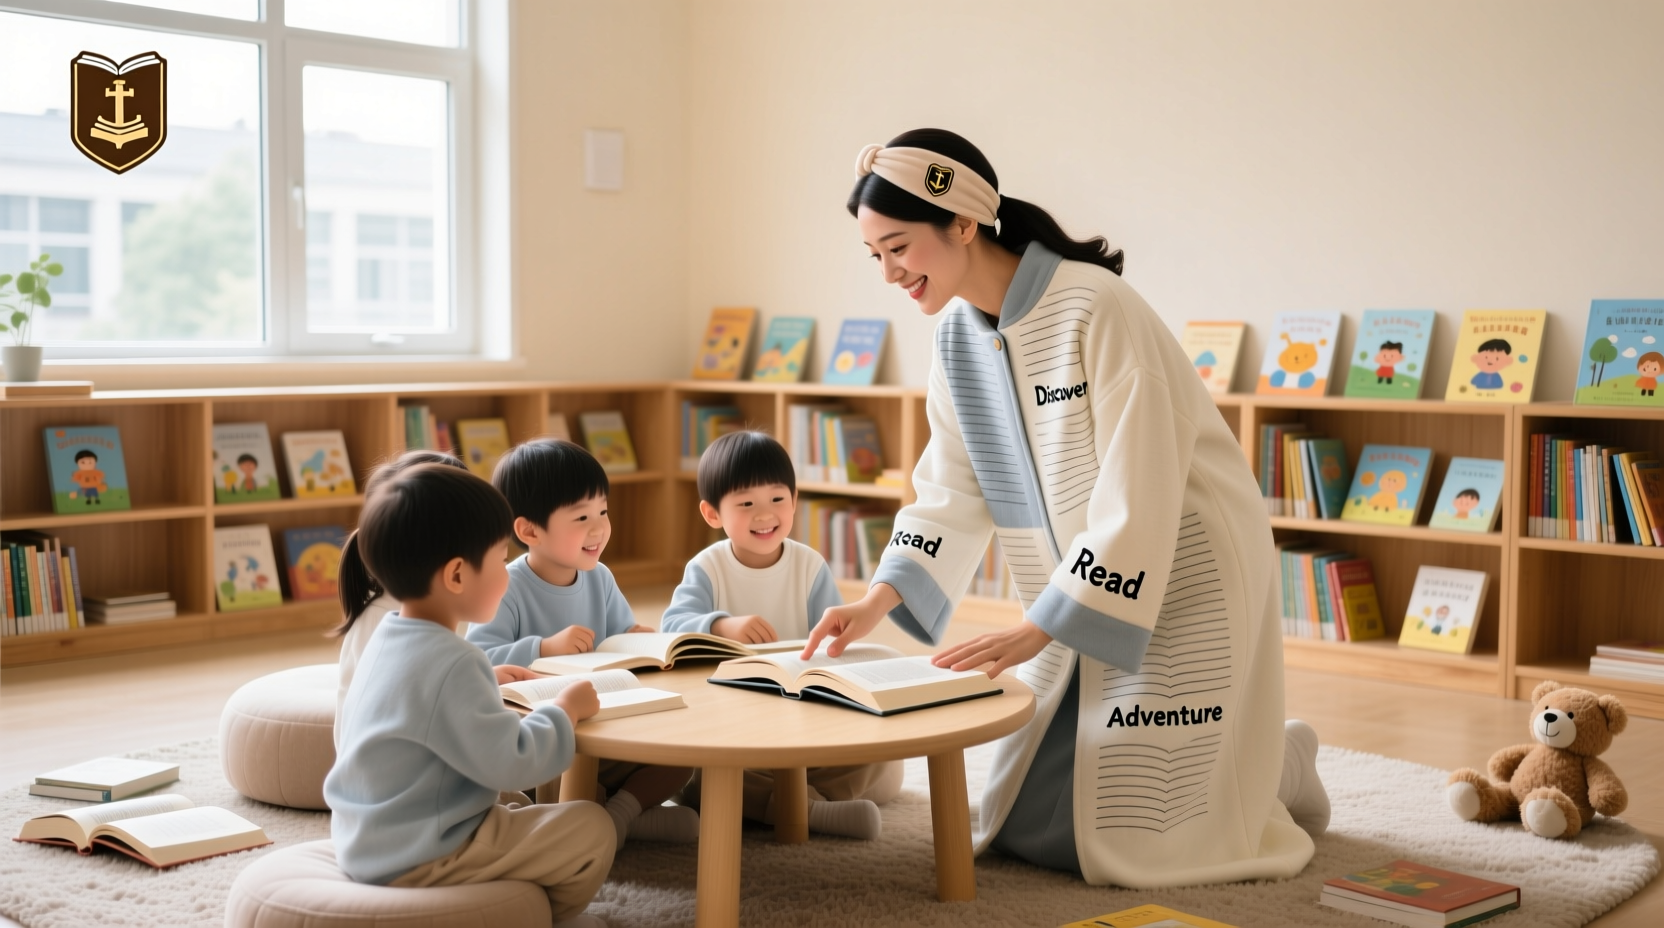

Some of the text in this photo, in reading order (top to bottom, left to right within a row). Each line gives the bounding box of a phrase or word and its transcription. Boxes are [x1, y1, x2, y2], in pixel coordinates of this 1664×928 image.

[890, 530, 943, 559] Read
[1070, 547, 1146, 601] Read
[1106, 704, 1223, 729] Adventure
